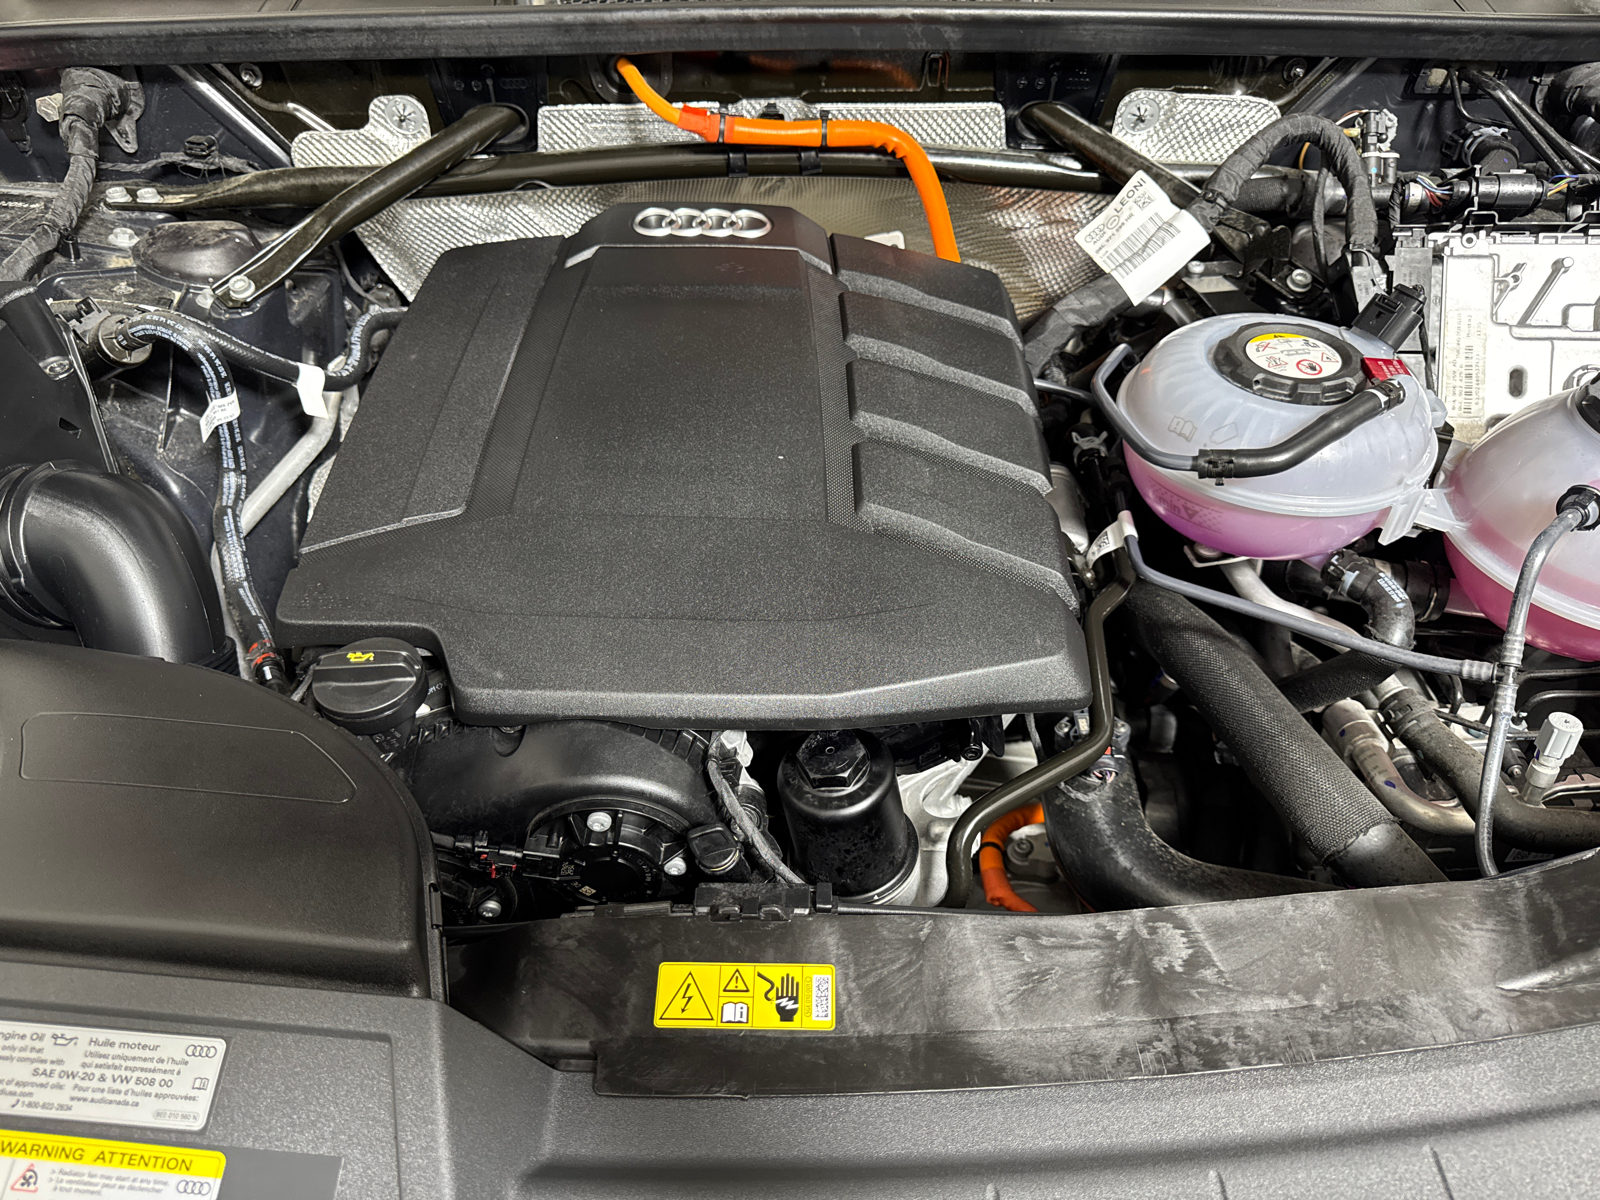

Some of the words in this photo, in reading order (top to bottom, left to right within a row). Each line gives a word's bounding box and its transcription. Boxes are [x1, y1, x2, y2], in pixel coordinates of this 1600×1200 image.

[1114, 178, 1147, 213] LEONI
[0, 1030, 27, 1041] ngine
[30, 1032, 46, 1042] Oil
[1, 1044, 17, 1053] only
[88, 1037, 116, 1048] Huile
[119, 1041, 161, 1052] moteur
[84, 1049, 111, 1059] Utilisez
[111, 1053, 155, 1063] uniquement
[156, 1055, 165, 1064] de
[81, 1060, 93, 1069] qui
[32, 1067, 57, 1078] SAE
[58, 1070, 95, 1081] 0W-20
[98, 1073, 108, 1082] &
[112, 1074, 133, 1085] VW
[135, 1076, 156, 1087] 508
[158, 1079, 174, 1088] 00
[0, 1088, 34, 1097] diusa.com
[72, 1083, 91, 1092] Pour
[91, 1086, 105, 1094] une
[107, 1086, 123, 1095] liste
[0, 1140, 85, 1161] WARNING
[94, 1150, 193, 1172] ATTENTION
